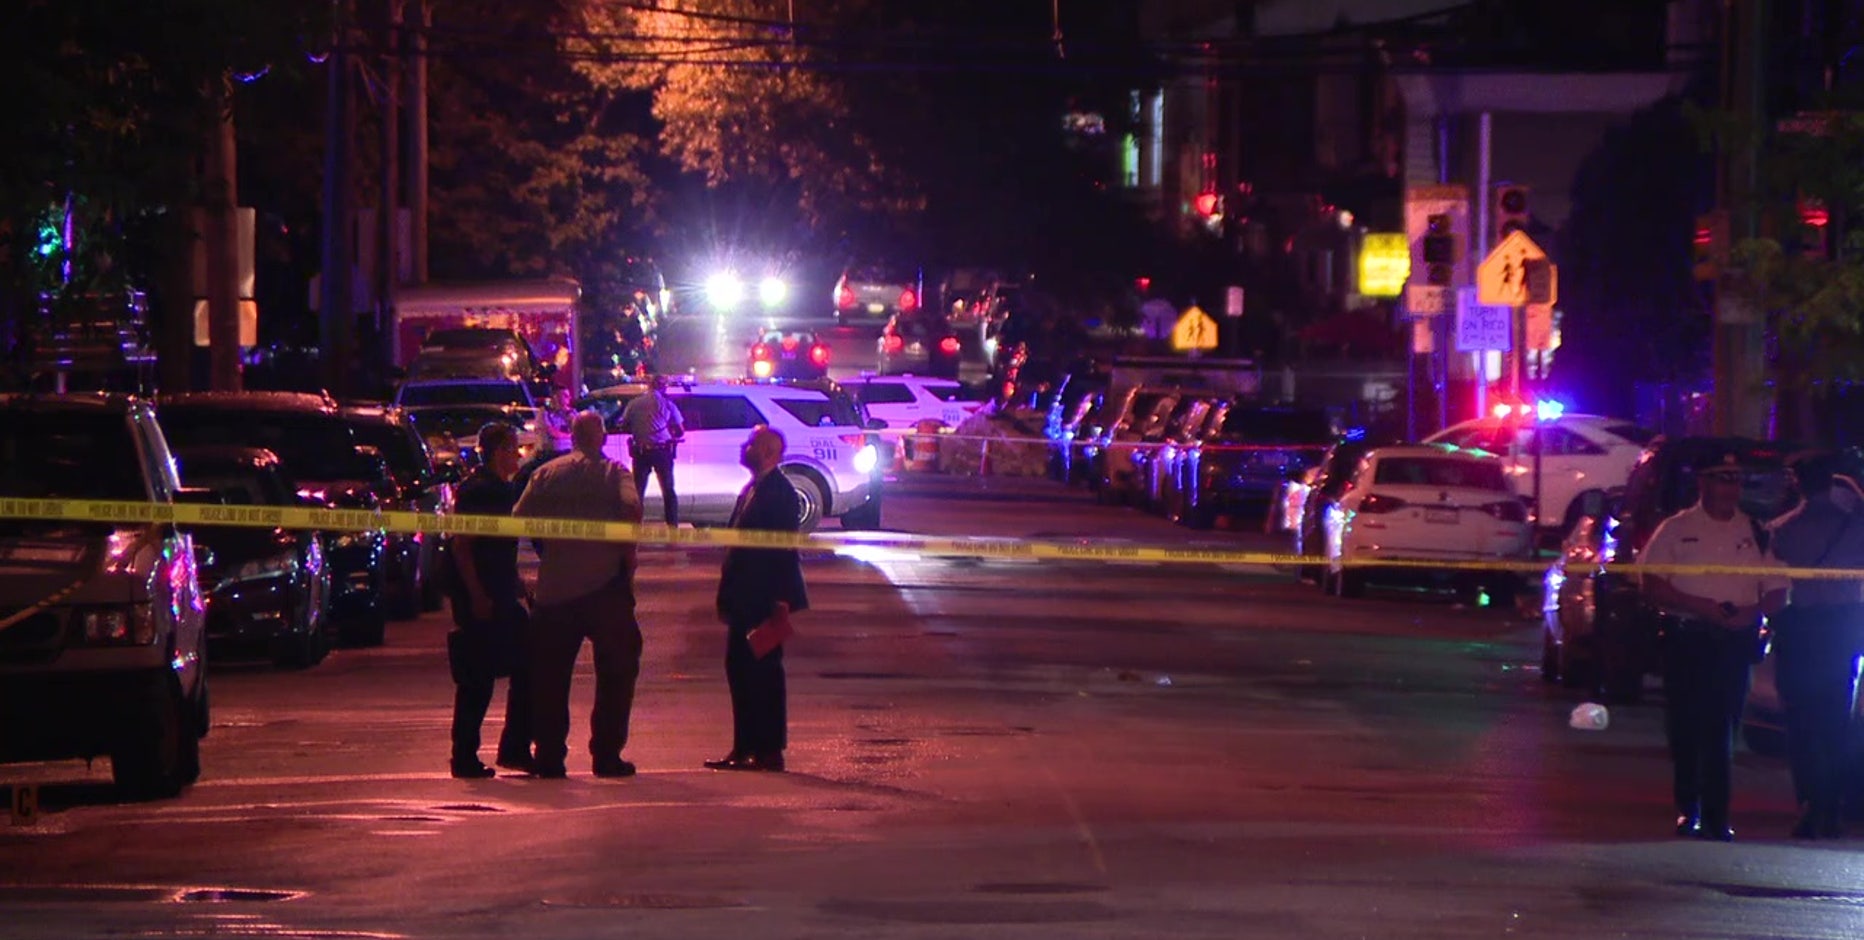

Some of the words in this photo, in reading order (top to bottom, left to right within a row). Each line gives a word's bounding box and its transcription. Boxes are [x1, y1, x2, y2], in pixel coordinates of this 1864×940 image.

[1482, 319, 1505, 330] RED
[810, 440, 834, 448] DIAL
[814, 448, 837, 460] 911
